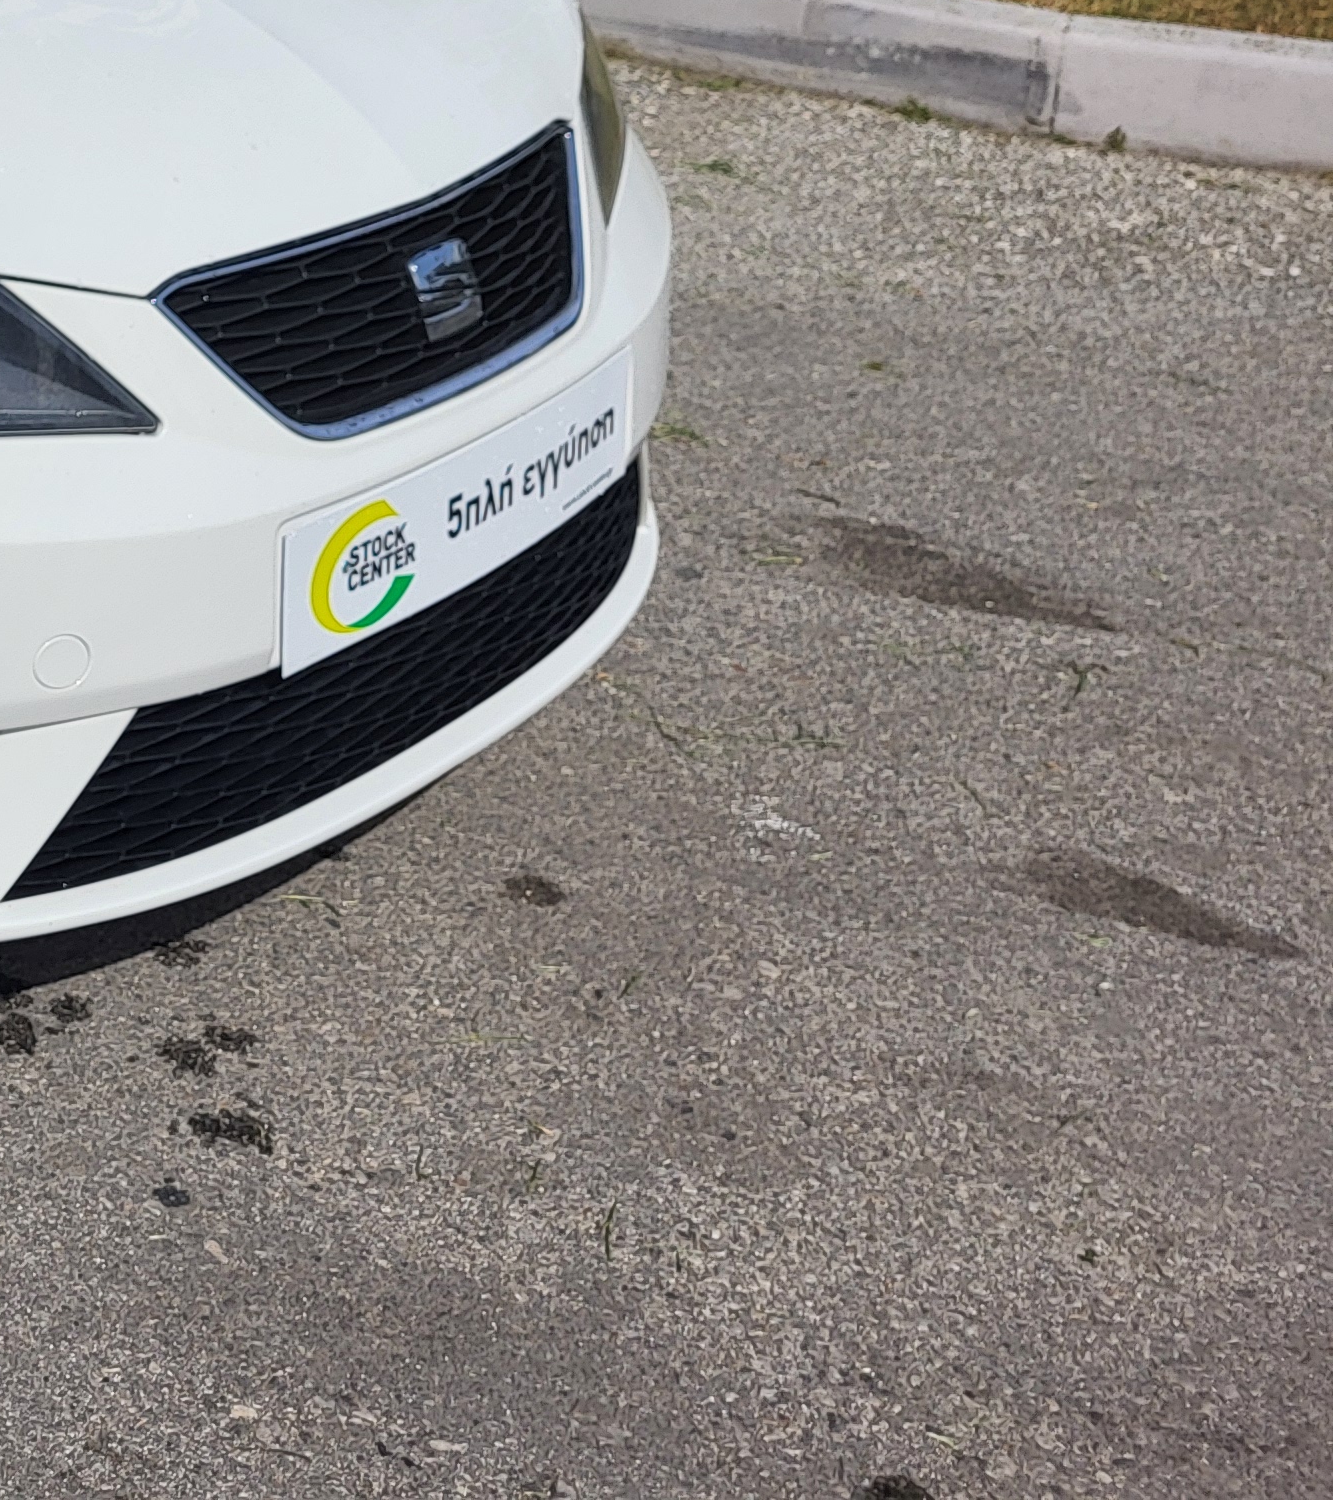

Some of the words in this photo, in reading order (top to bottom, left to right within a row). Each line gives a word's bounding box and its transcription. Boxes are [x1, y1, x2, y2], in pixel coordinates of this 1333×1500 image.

[447, 462, 515, 538] 5πλή
[343, 521, 407, 574] STOCK
[348, 542, 416, 592] CENTER
